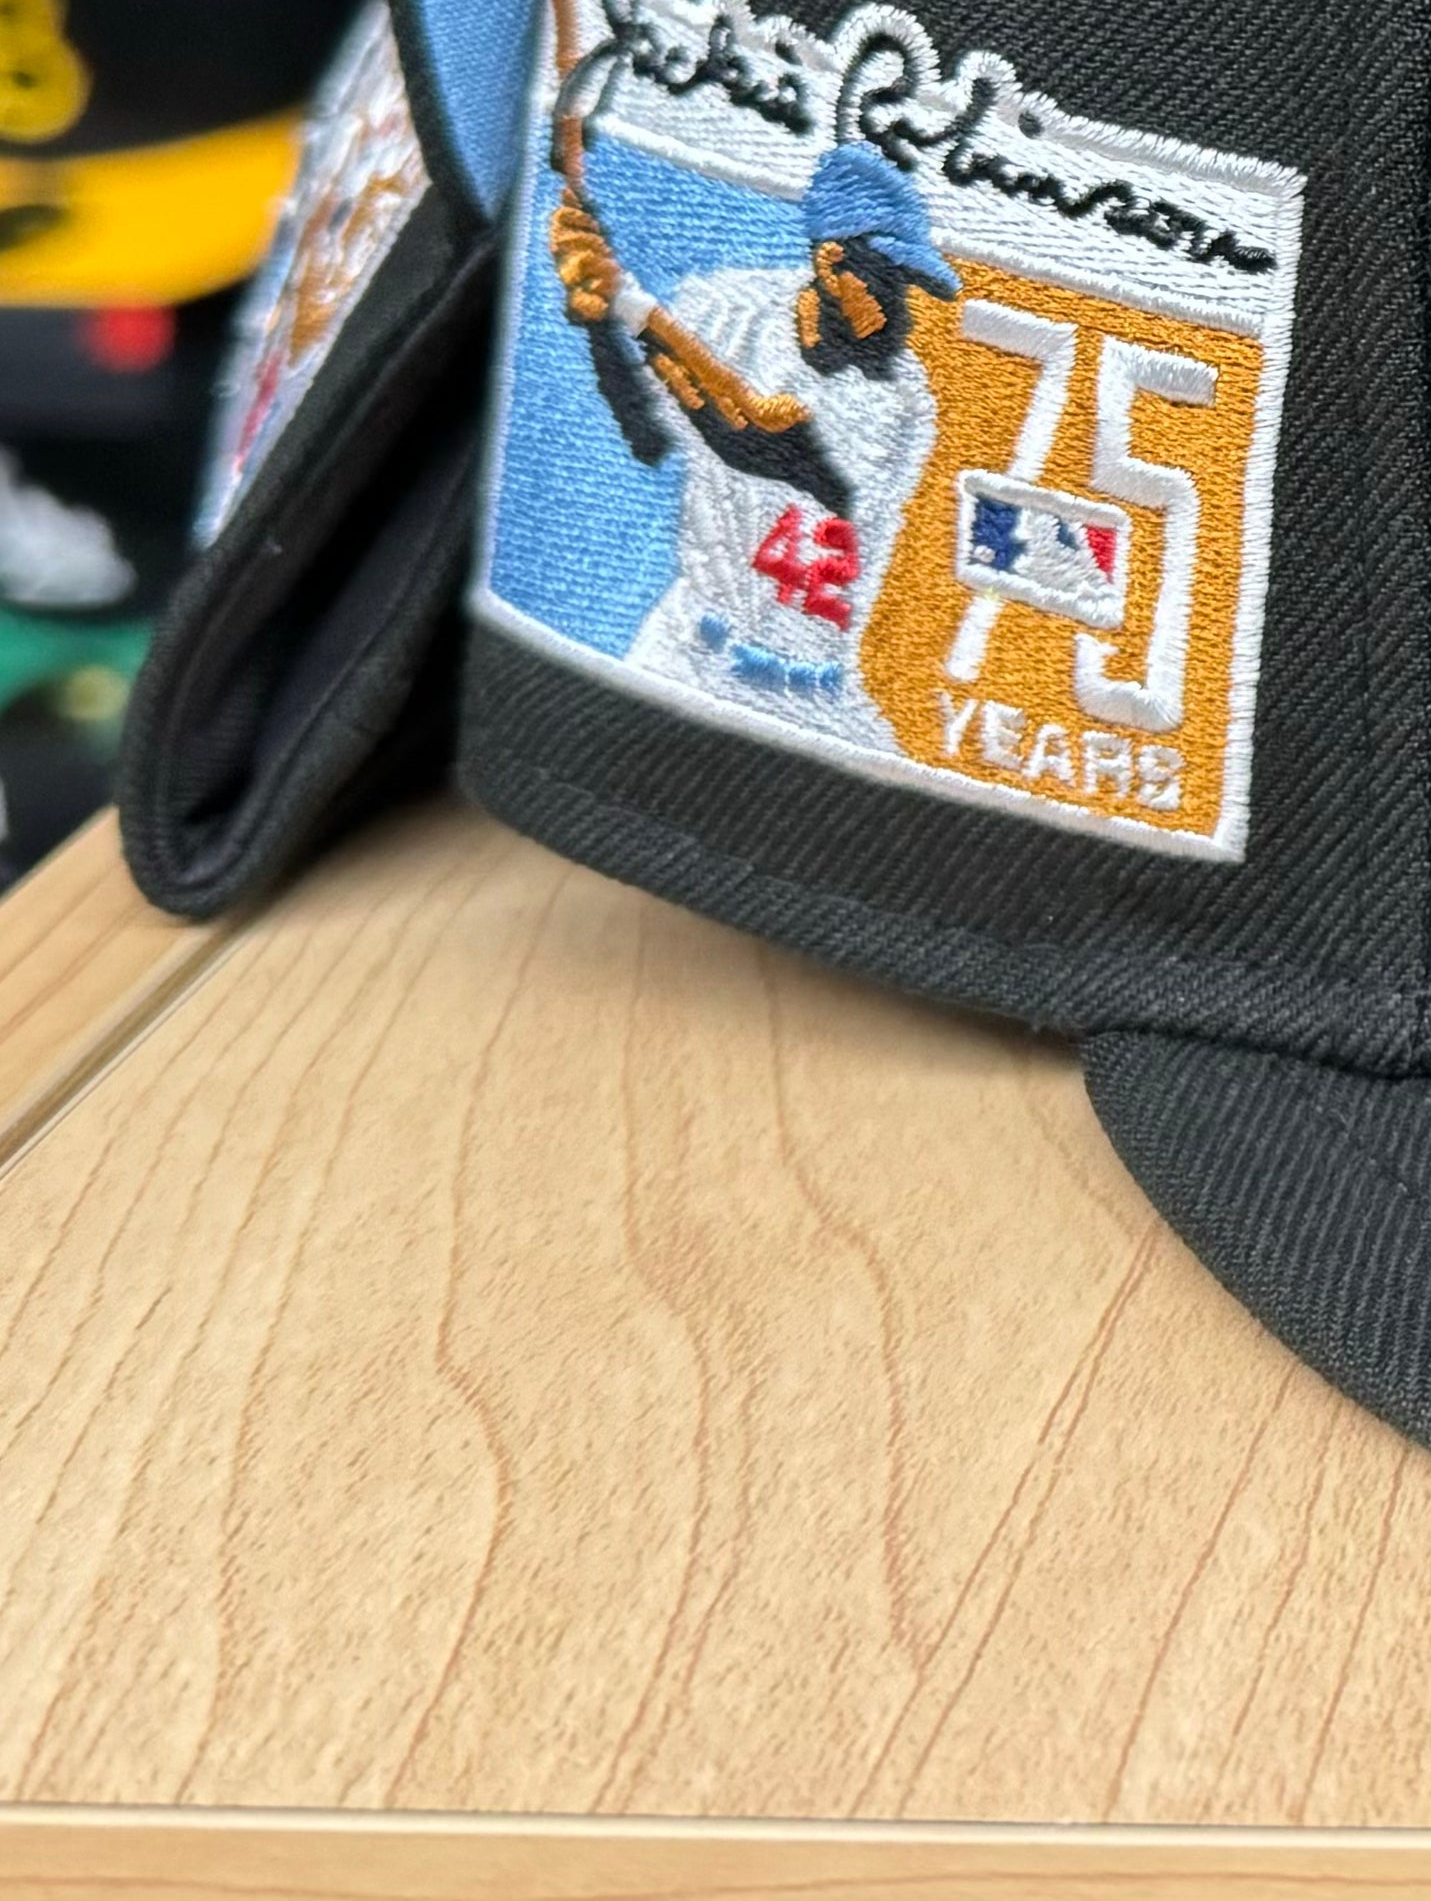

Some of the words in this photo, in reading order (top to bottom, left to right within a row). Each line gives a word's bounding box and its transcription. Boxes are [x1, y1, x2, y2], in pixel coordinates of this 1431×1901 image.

[752, 501, 862, 633] 42
[943, 297, 1219, 733] 75
[941, 697, 1186, 815] YEARS
